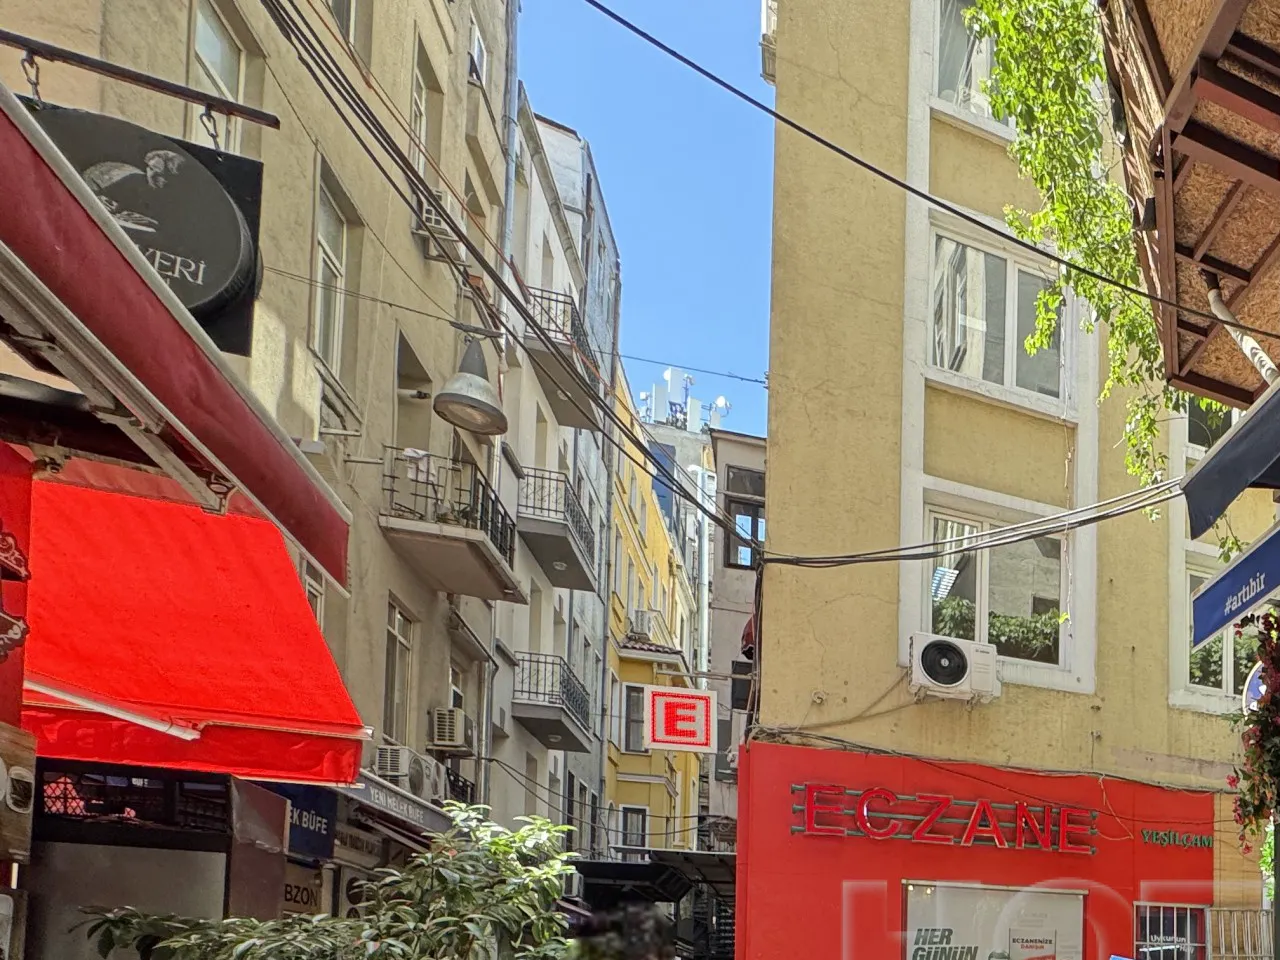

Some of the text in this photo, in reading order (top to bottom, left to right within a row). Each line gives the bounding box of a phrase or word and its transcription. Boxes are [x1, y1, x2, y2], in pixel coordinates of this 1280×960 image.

[664, 701, 698, 738] E
[387, 796, 408, 817] MELEK
[802, 781, 1095, 854] ECZANE
[301, 810, 328, 834] BÜFE
[1140, 828, 1213, 849] YEŞİLÇAM
[913, 928, 954, 946] HER
